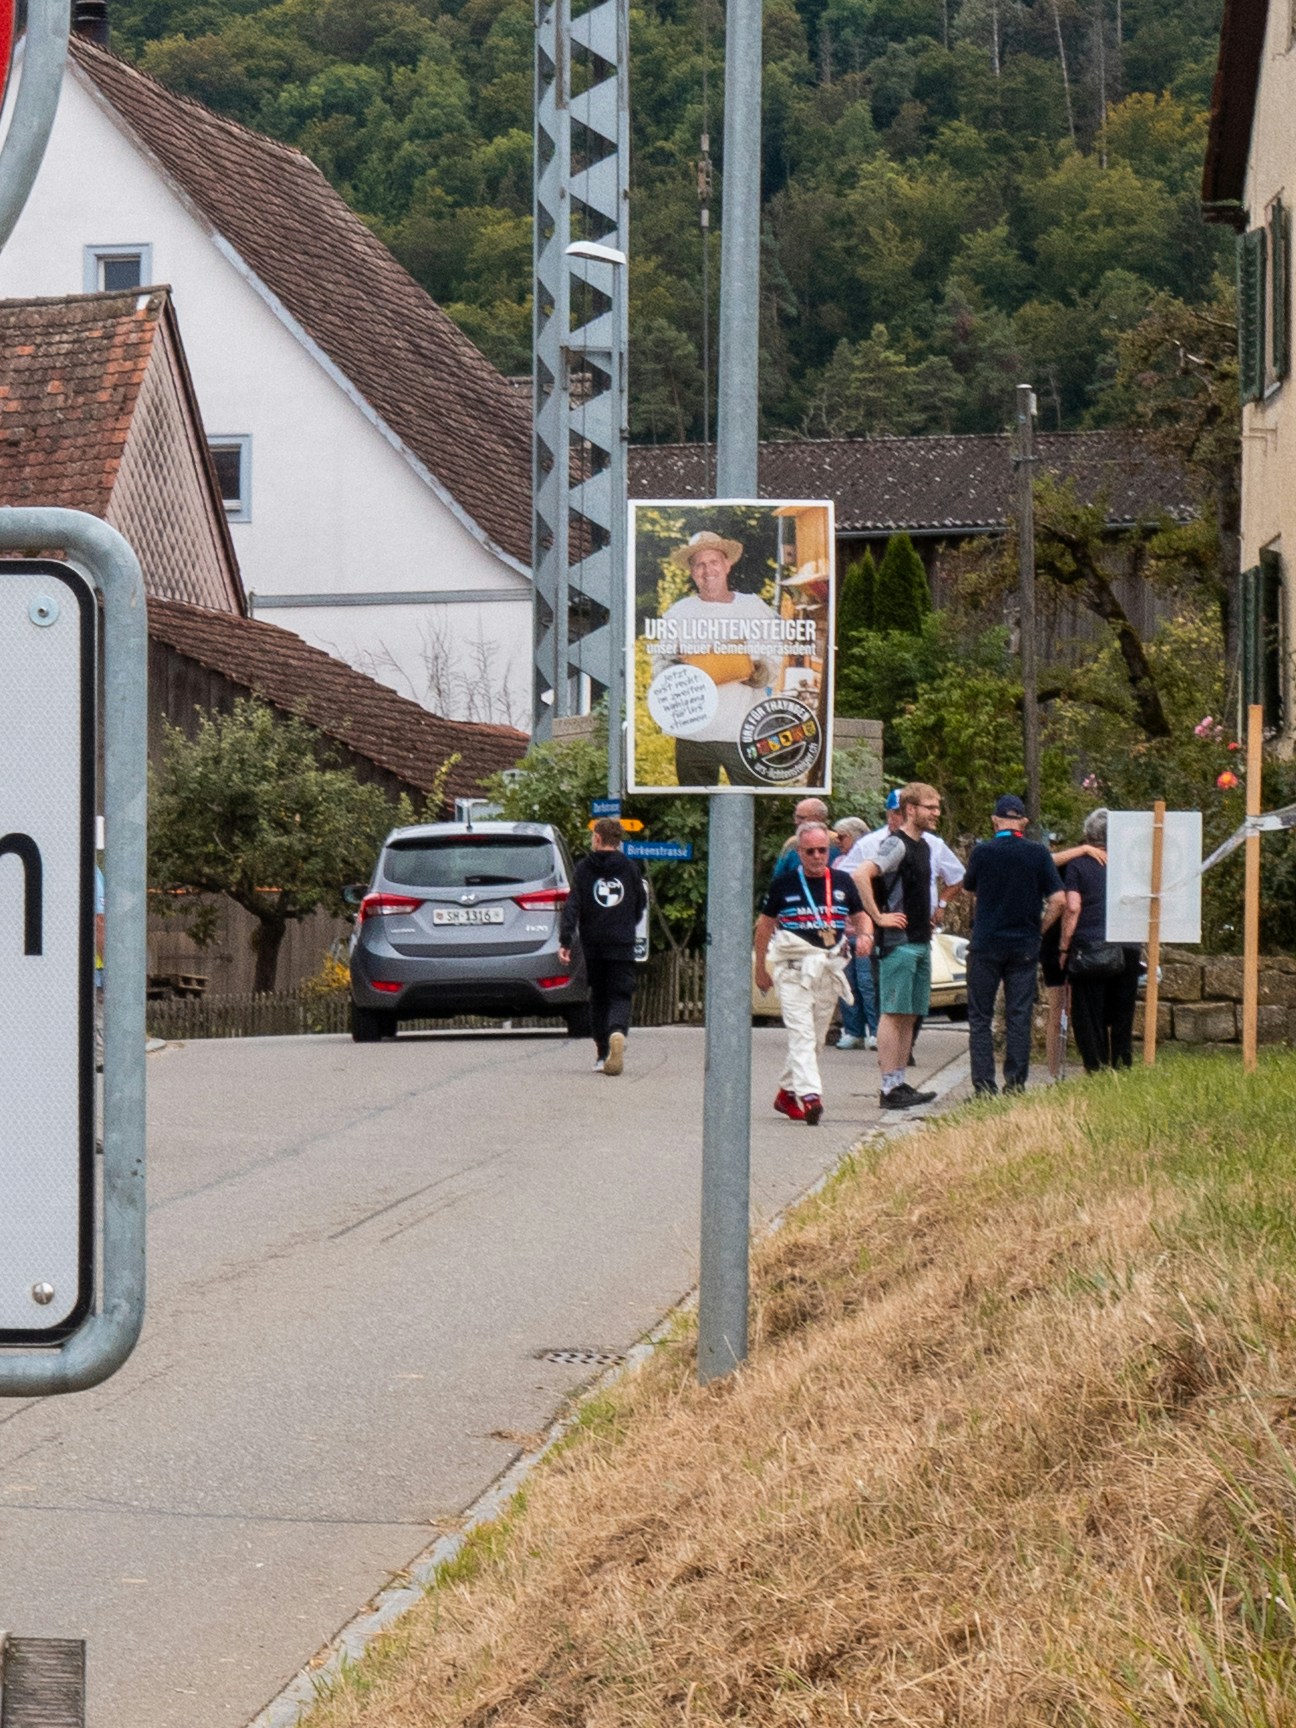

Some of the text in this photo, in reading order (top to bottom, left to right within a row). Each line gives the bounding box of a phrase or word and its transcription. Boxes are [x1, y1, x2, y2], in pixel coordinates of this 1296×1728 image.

[645, 618, 817, 641] URS LICHTENSTEIGER
[679, 642, 711, 655] neuer
[627, 845, 688, 858] Birkenstrasse
